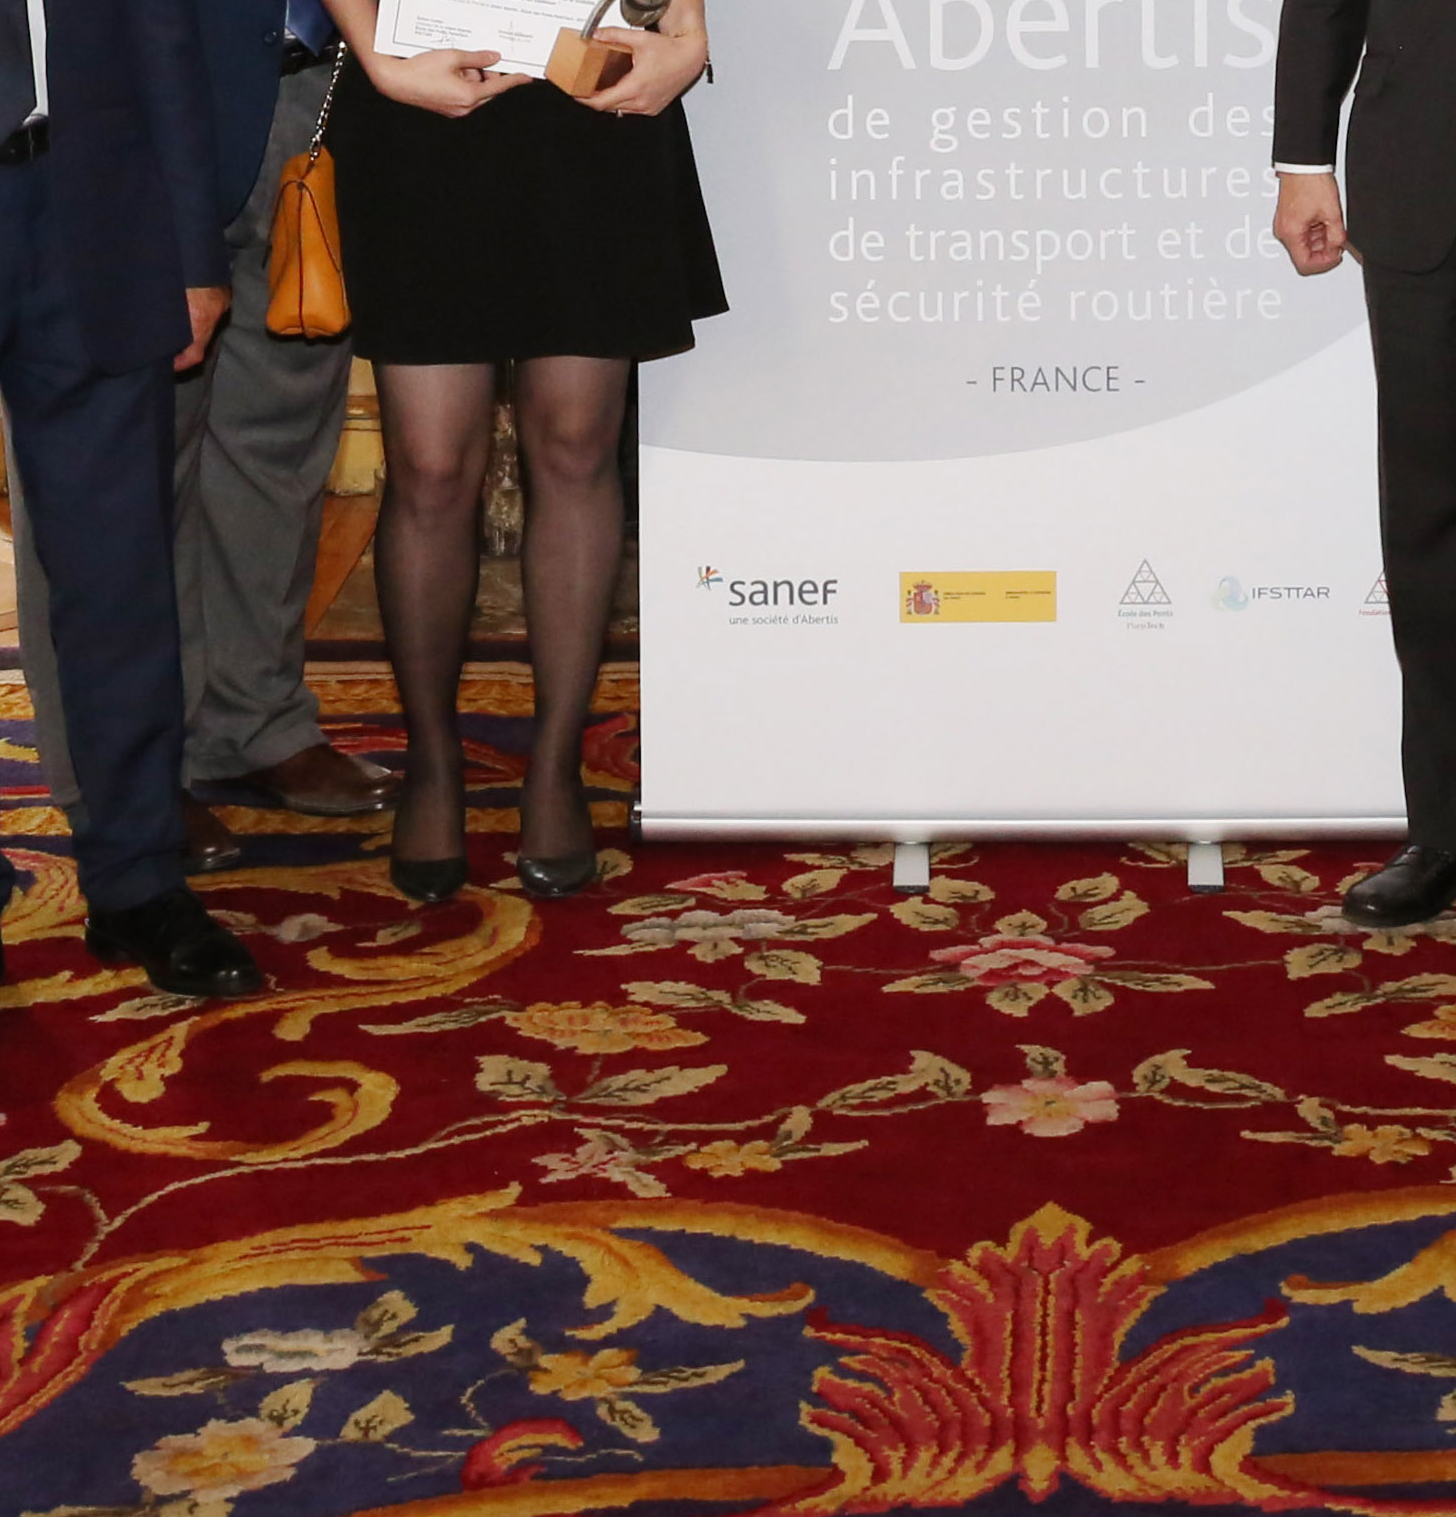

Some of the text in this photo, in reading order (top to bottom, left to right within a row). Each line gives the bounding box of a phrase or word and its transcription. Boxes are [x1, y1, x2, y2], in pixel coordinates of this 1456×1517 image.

[828, 93, 1275, 151] de gestion des
[828, 156, 1280, 201] infrastructures
[828, 216, 1282, 273] de transport et de
[828, 277, 1282, 324] sécurité routière
[993, 366, 1119, 392] FRANCE
[729, 580, 837, 606] sanef
[1252, 587, 1330, 599] IFSTTAR
[752, 615, 789, 625] société
[792, 614, 838, 624] d'Abertis
